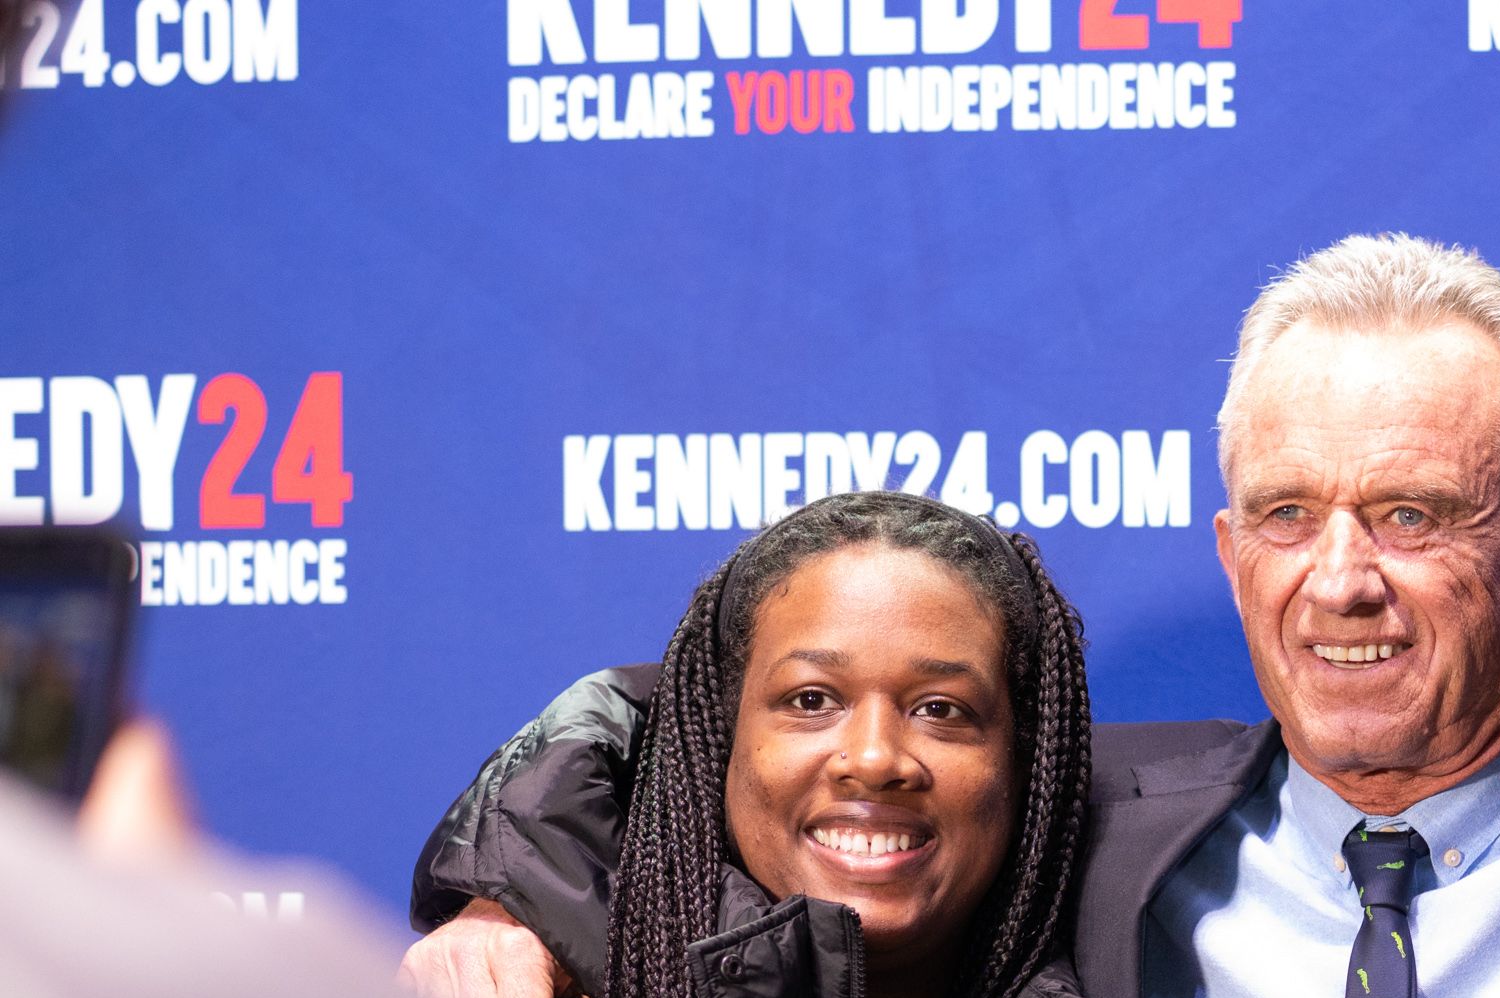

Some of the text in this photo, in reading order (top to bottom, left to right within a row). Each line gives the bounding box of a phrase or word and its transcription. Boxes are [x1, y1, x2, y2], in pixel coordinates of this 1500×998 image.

[0, 0, 299, 89] 24.COM
[508, 62, 1237, 143] DECLARE YOUR INDEPENDENCE
[0, 371, 354, 531] EDY24
[563, 429, 1192, 532] KENNEDY24.COM
[123, 538, 348, 606] ENDENCE
